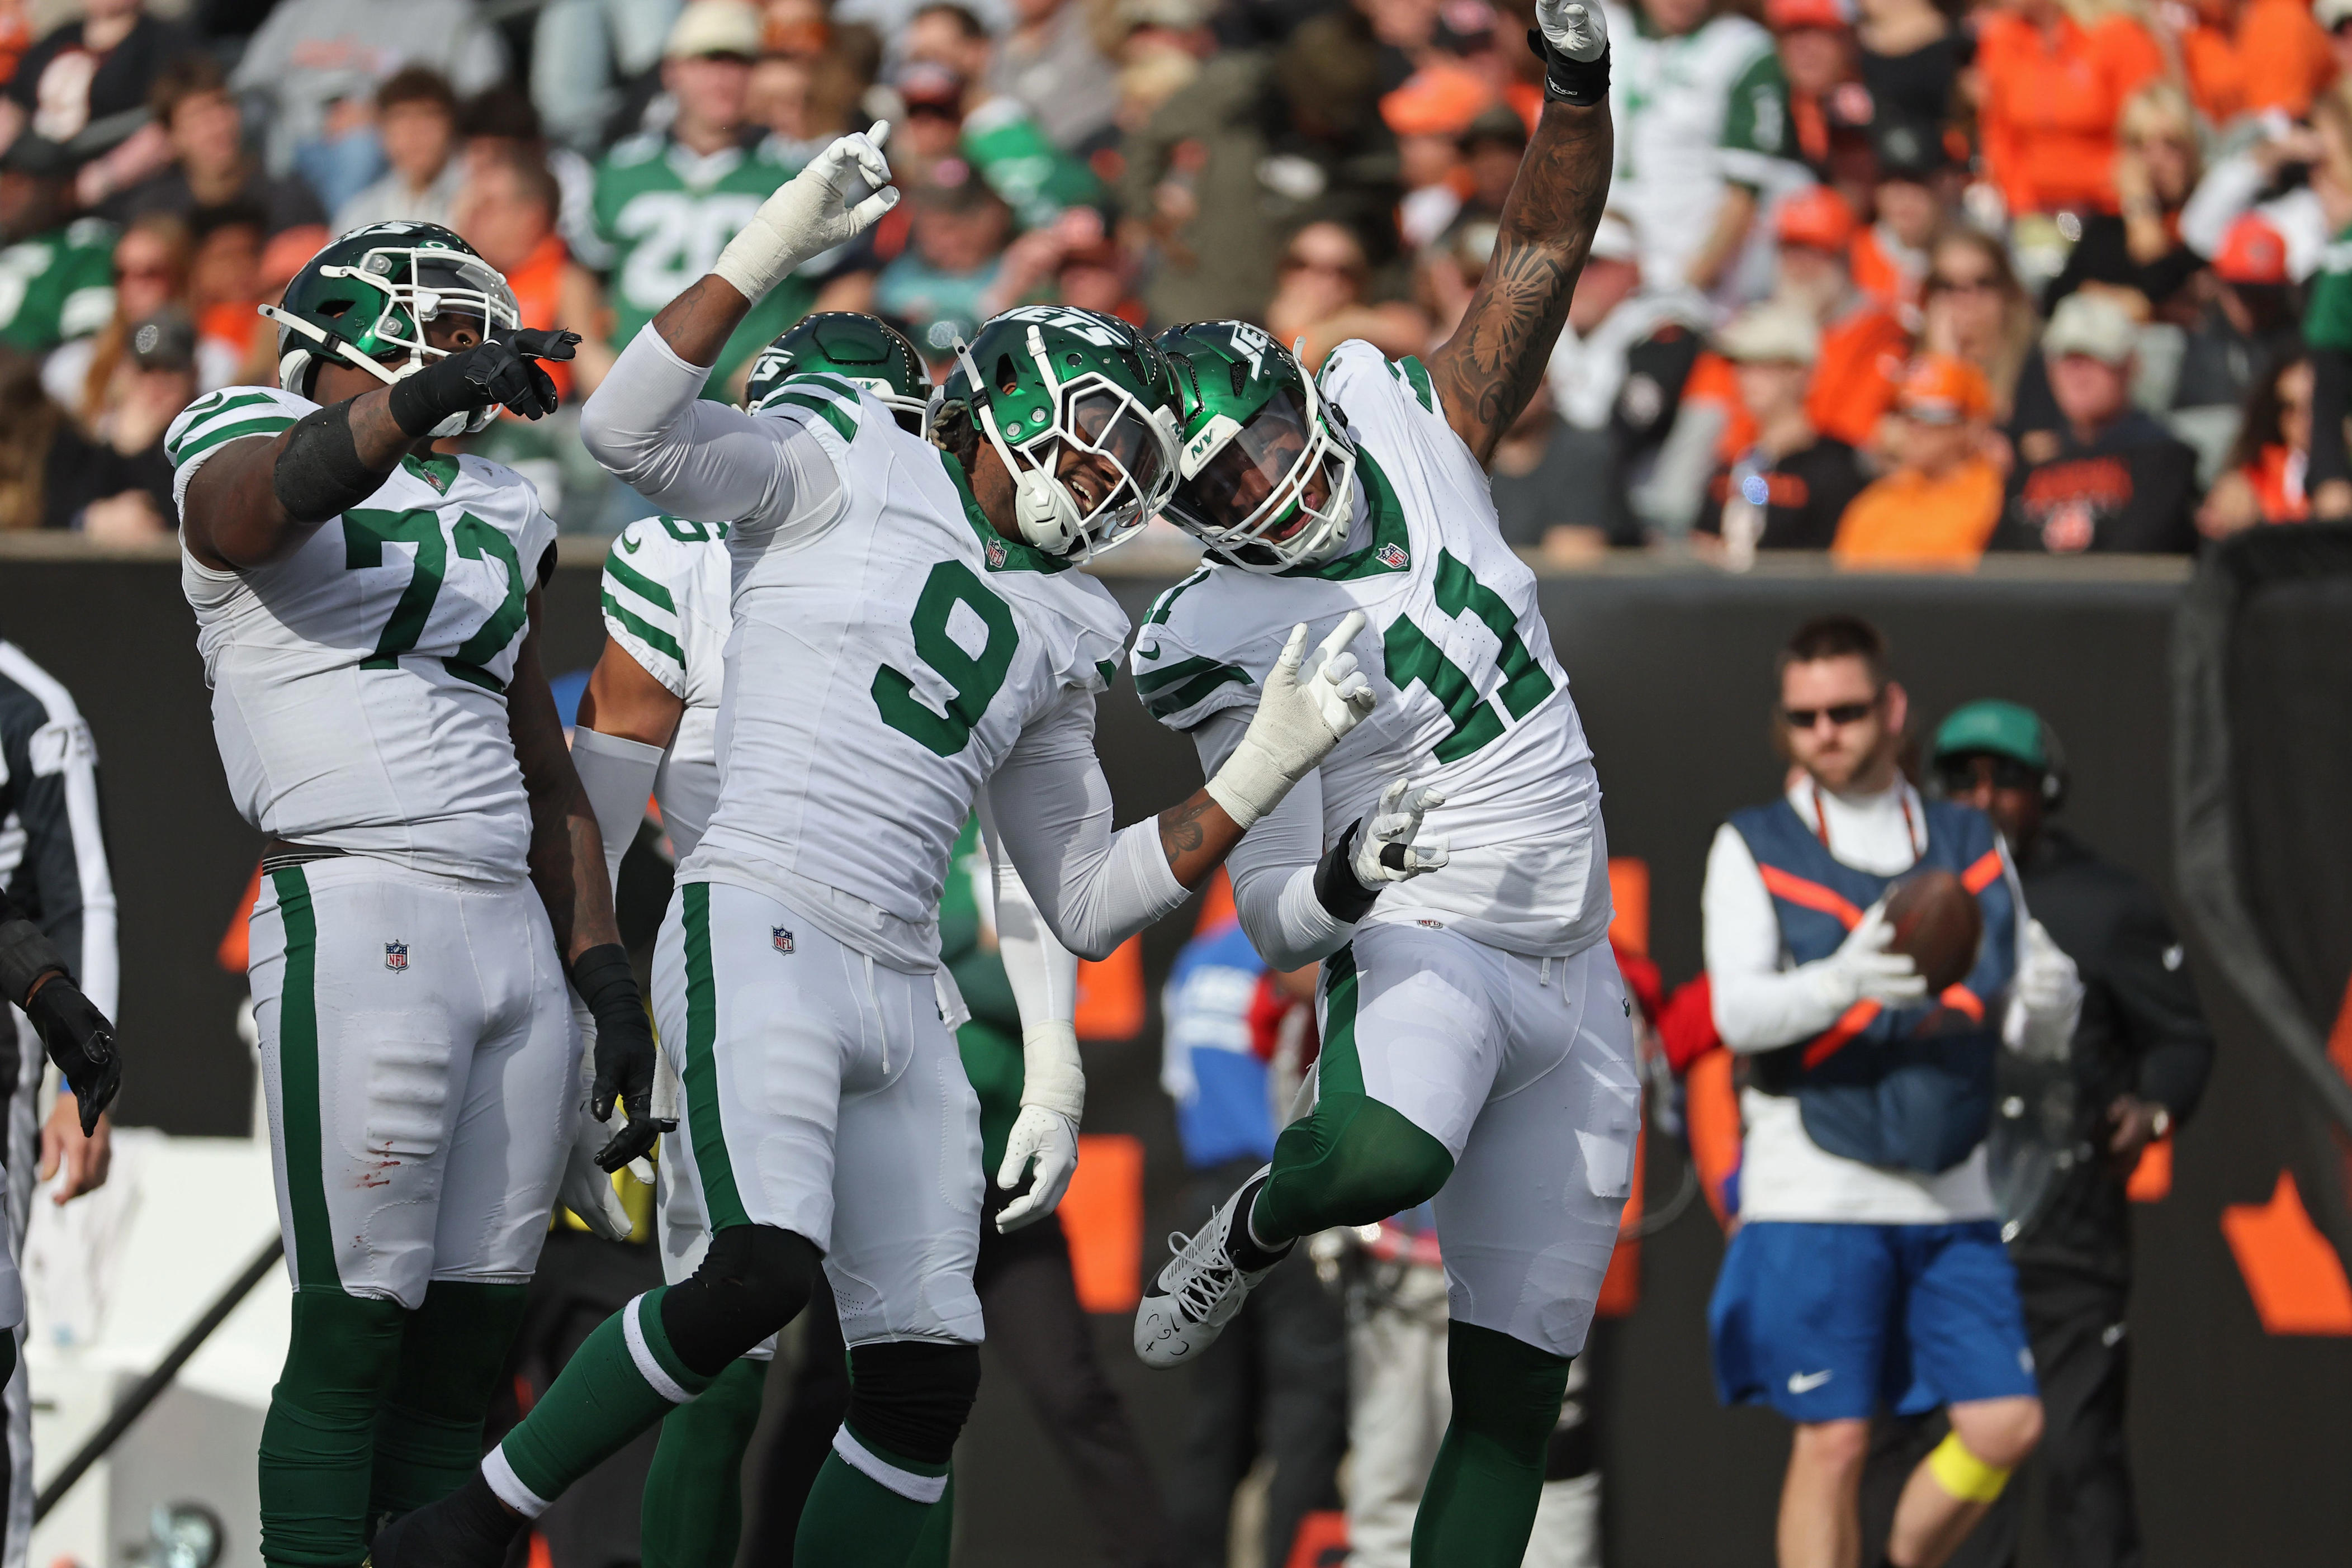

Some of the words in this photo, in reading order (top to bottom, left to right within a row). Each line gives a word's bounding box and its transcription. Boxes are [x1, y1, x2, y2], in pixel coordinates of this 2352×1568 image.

[1191, 428, 1213, 460] NY
[342, 508, 528, 694] 72
[1384, 546, 1555, 765] 11
[871, 559, 1019, 758] 9
[389, 954, 406, 967] NFL
[775, 936, 792, 950] NFL
